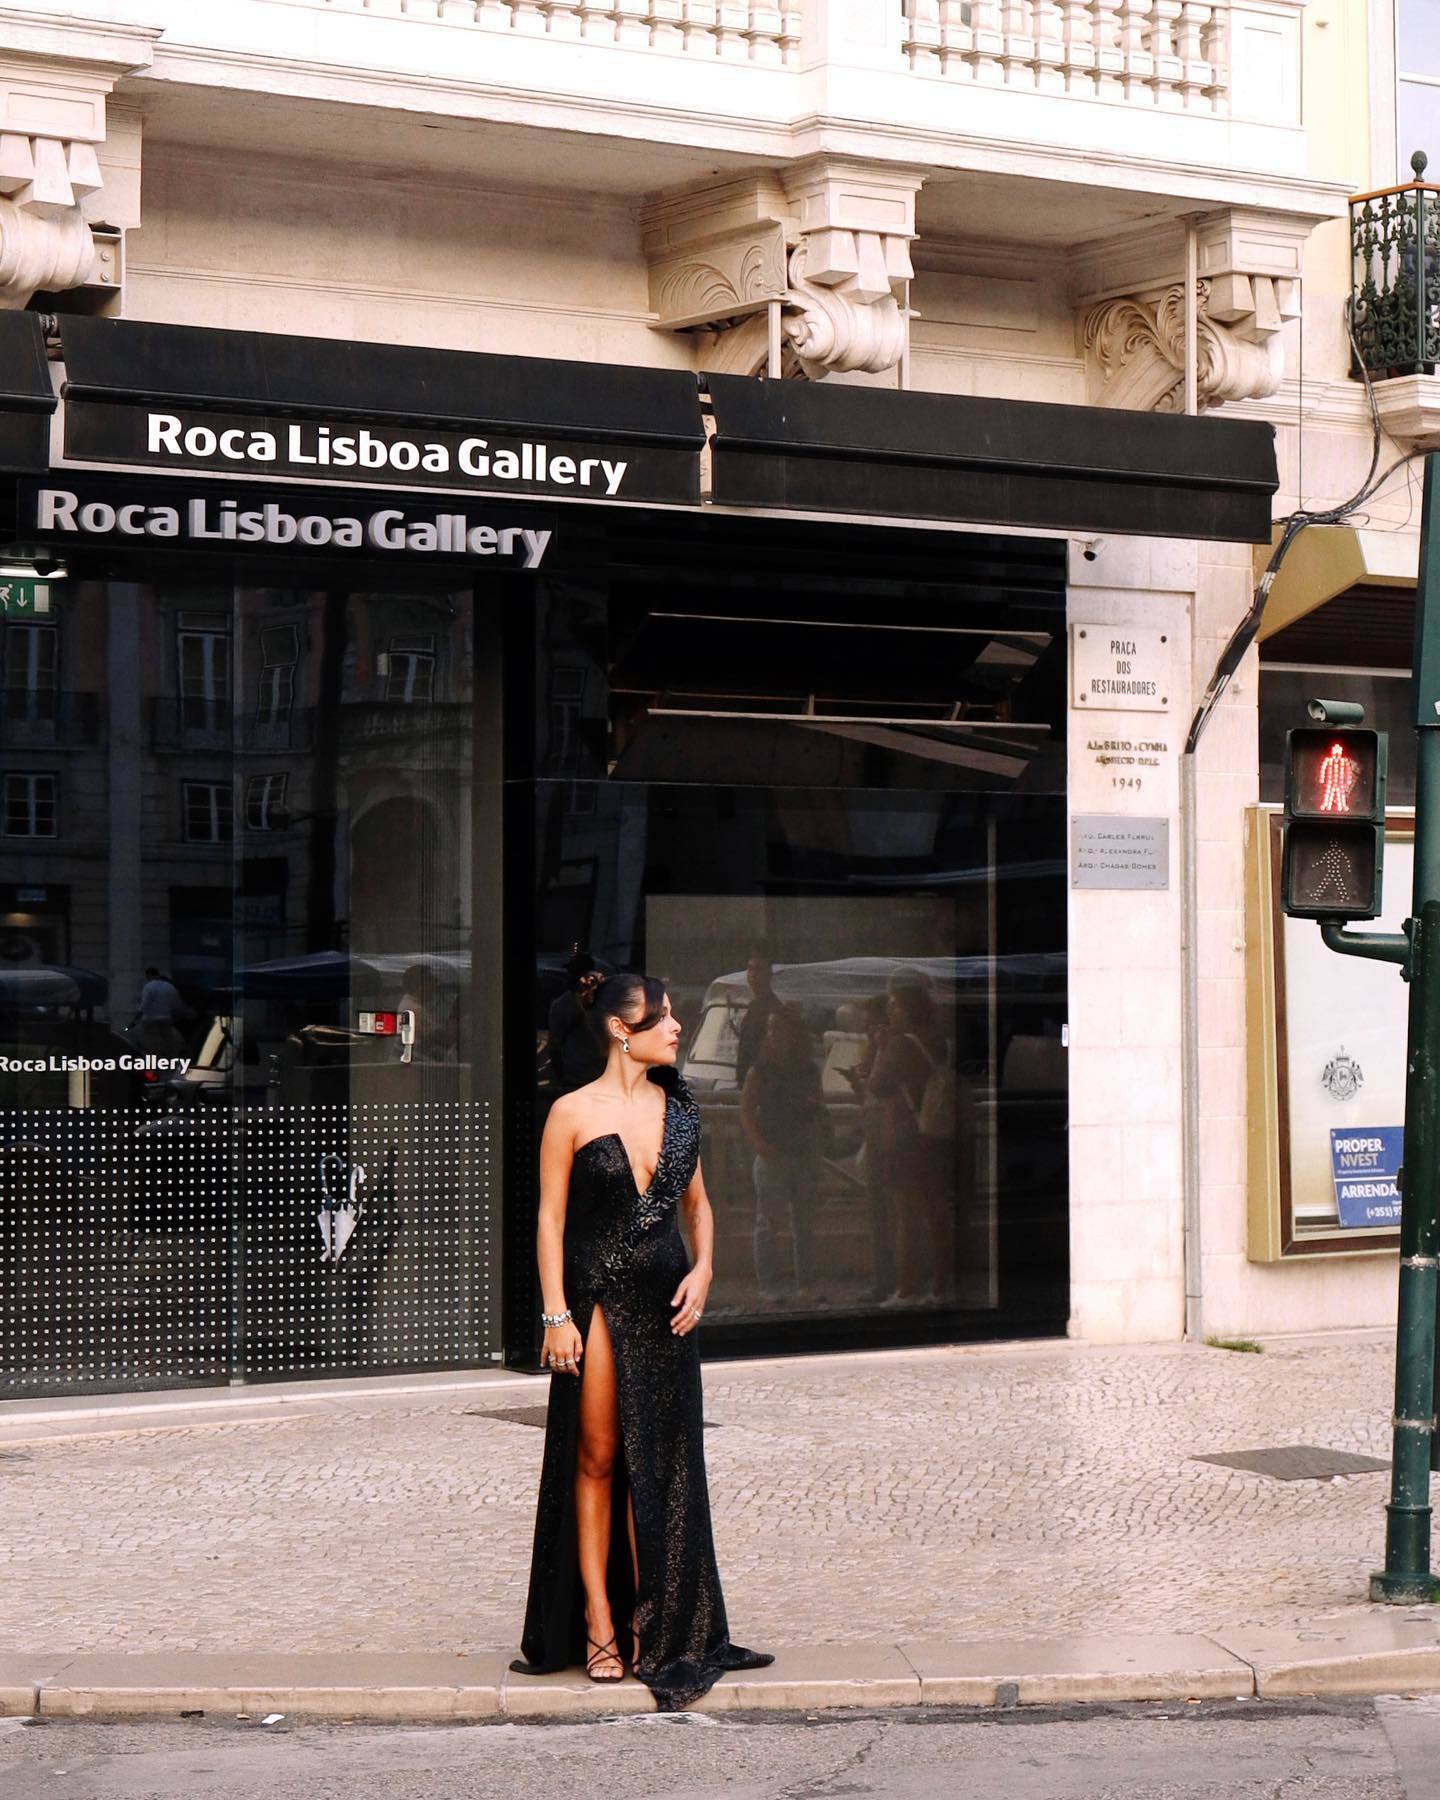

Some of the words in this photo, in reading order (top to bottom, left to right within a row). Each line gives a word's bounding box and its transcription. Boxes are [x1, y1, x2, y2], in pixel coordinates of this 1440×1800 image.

[148, 413, 276, 460] Roca
[288, 424, 449, 472] Lisboa
[458, 438, 627, 495] Gallery
[37, 489, 179, 536] Roca
[188, 498, 362, 547] Lisboa
[368, 509, 552, 568] Gallery
[1116, 660, 1132, 674] DOS
[1091, 679, 1156, 696] RESTAURADORES
[1112, 777, 1142, 792] 1949
[0, 1056, 46, 1072] Roca
[49, 1055, 116, 1071] Lisboa
[118, 1054, 191, 1075] Gallery
